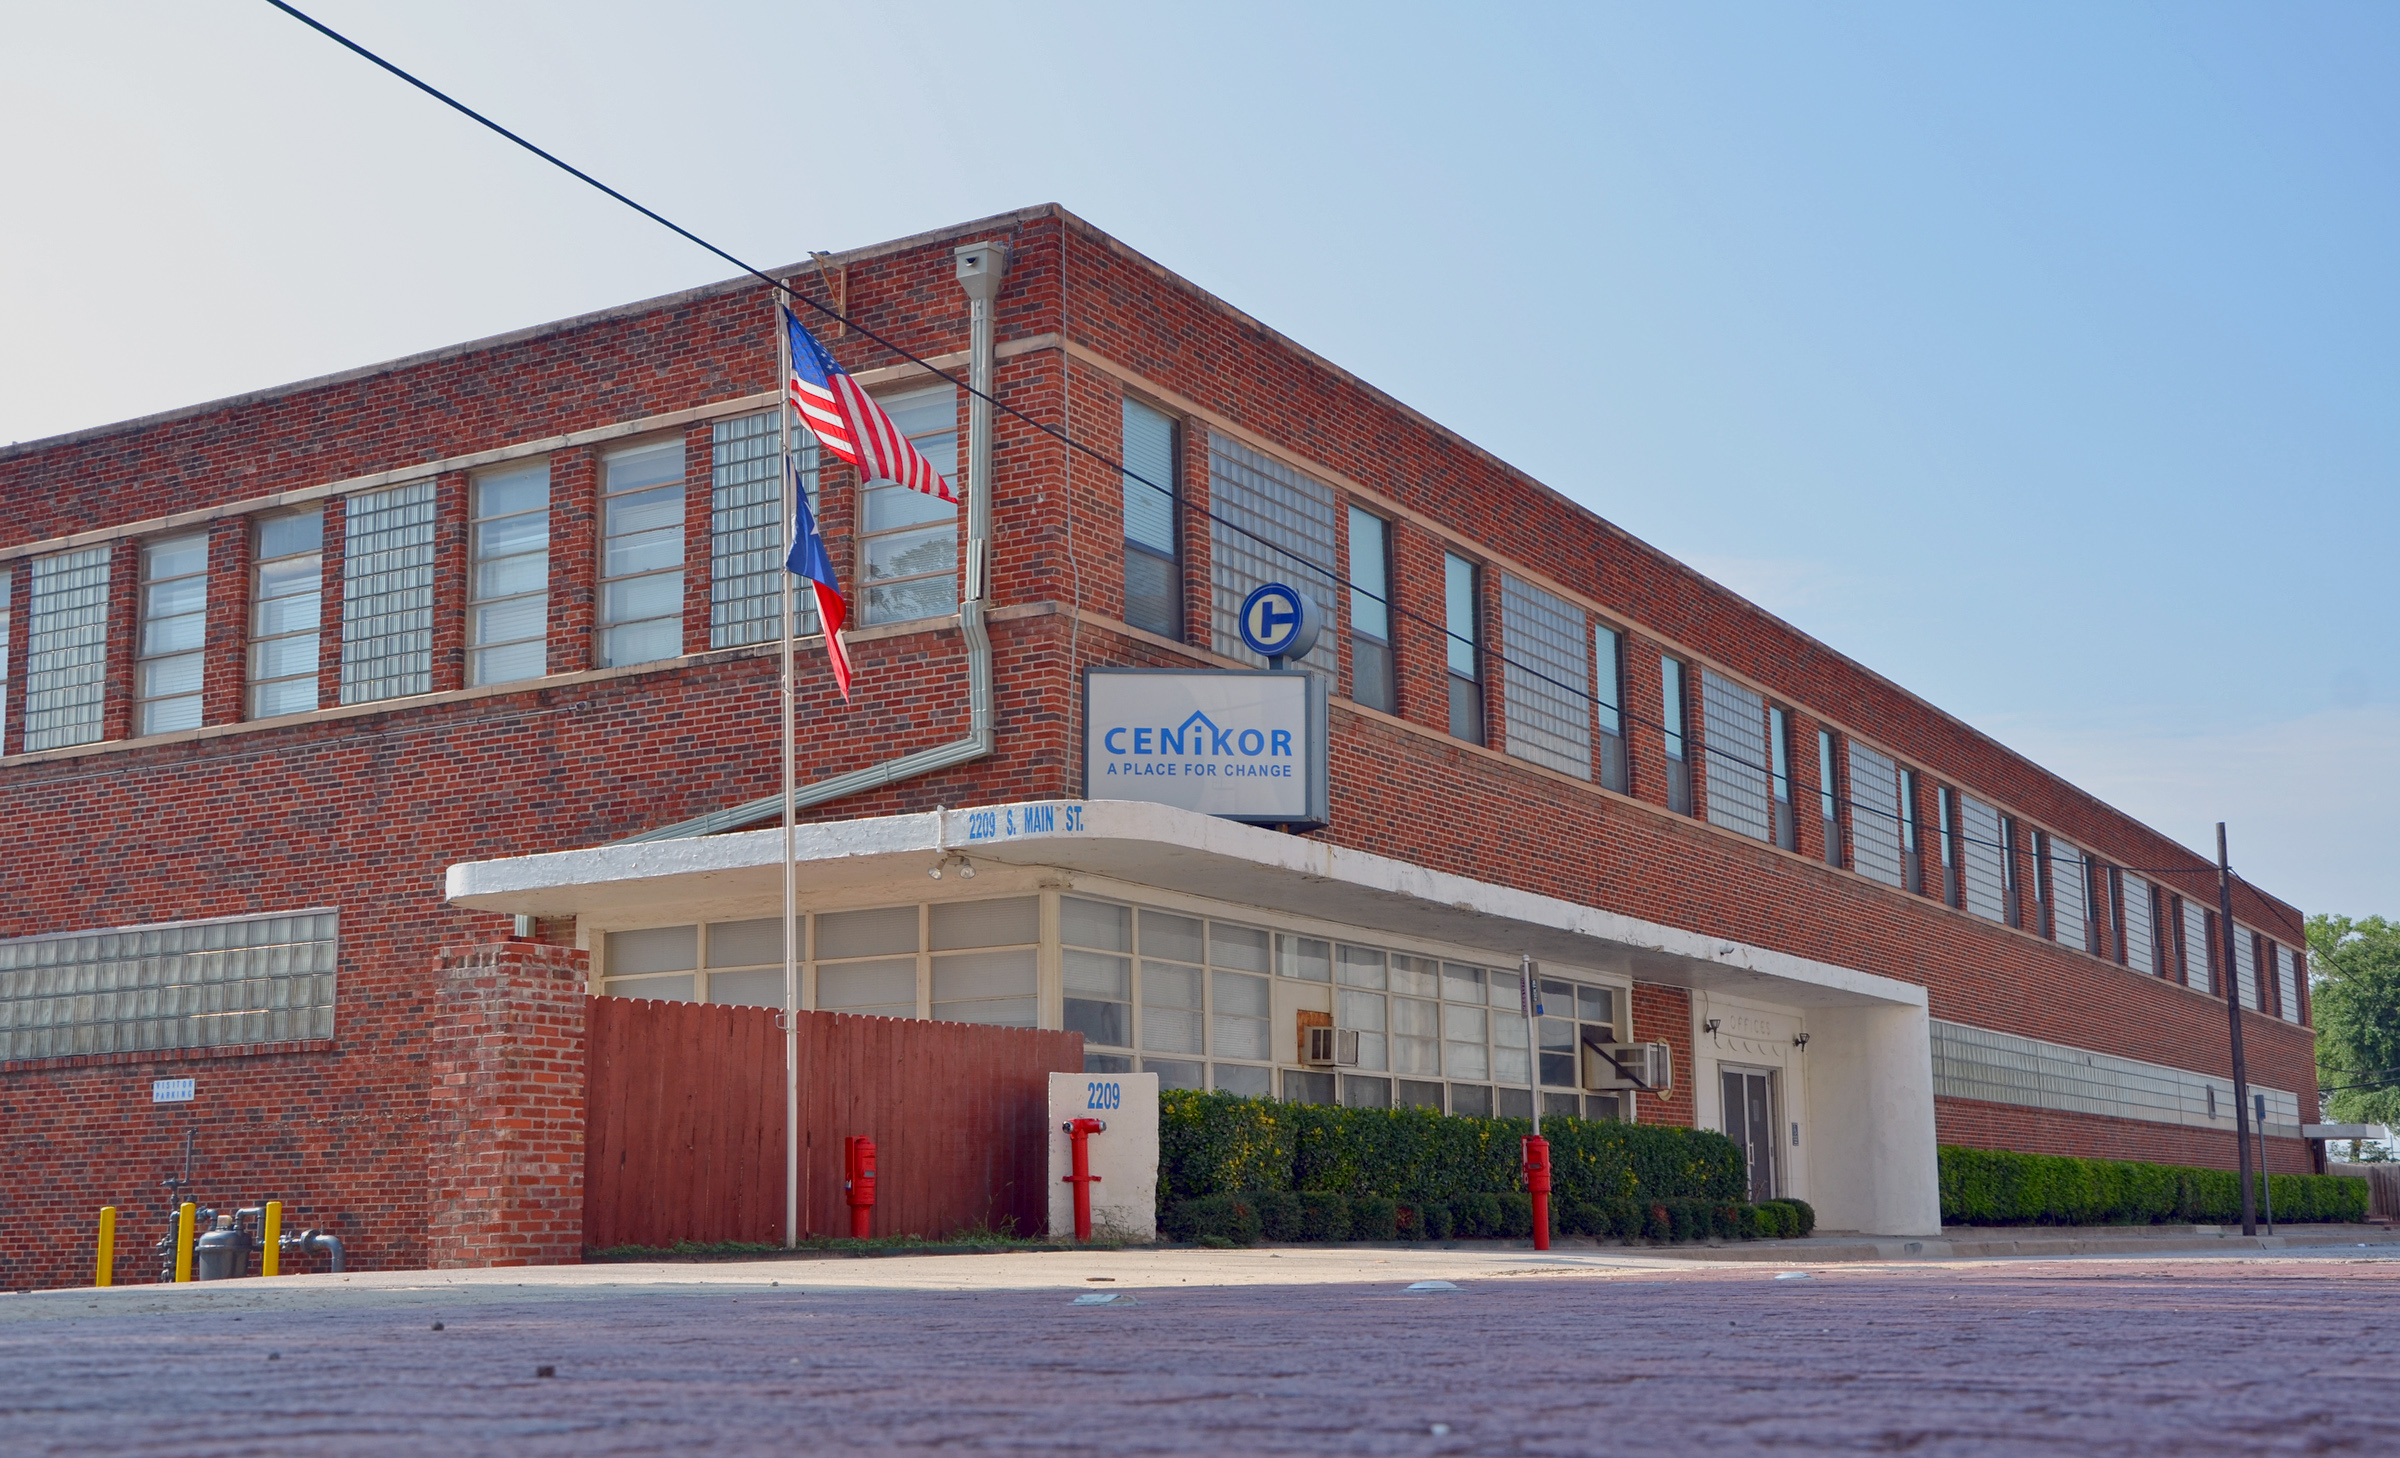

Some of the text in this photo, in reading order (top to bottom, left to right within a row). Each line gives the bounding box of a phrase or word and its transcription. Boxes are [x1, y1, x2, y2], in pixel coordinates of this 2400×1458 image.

[1107, 763, 1292, 777] A PLACE FOR CHANGE
[969, 805, 1084, 840] 2209 S. MAIN ST.
[1730, 1015, 1770, 1036] OFFICES
[155, 1080, 193, 1089] VISITOR
[155, 1090, 192, 1100] PARKING
[1087, 1082, 1120, 1110] 2209
